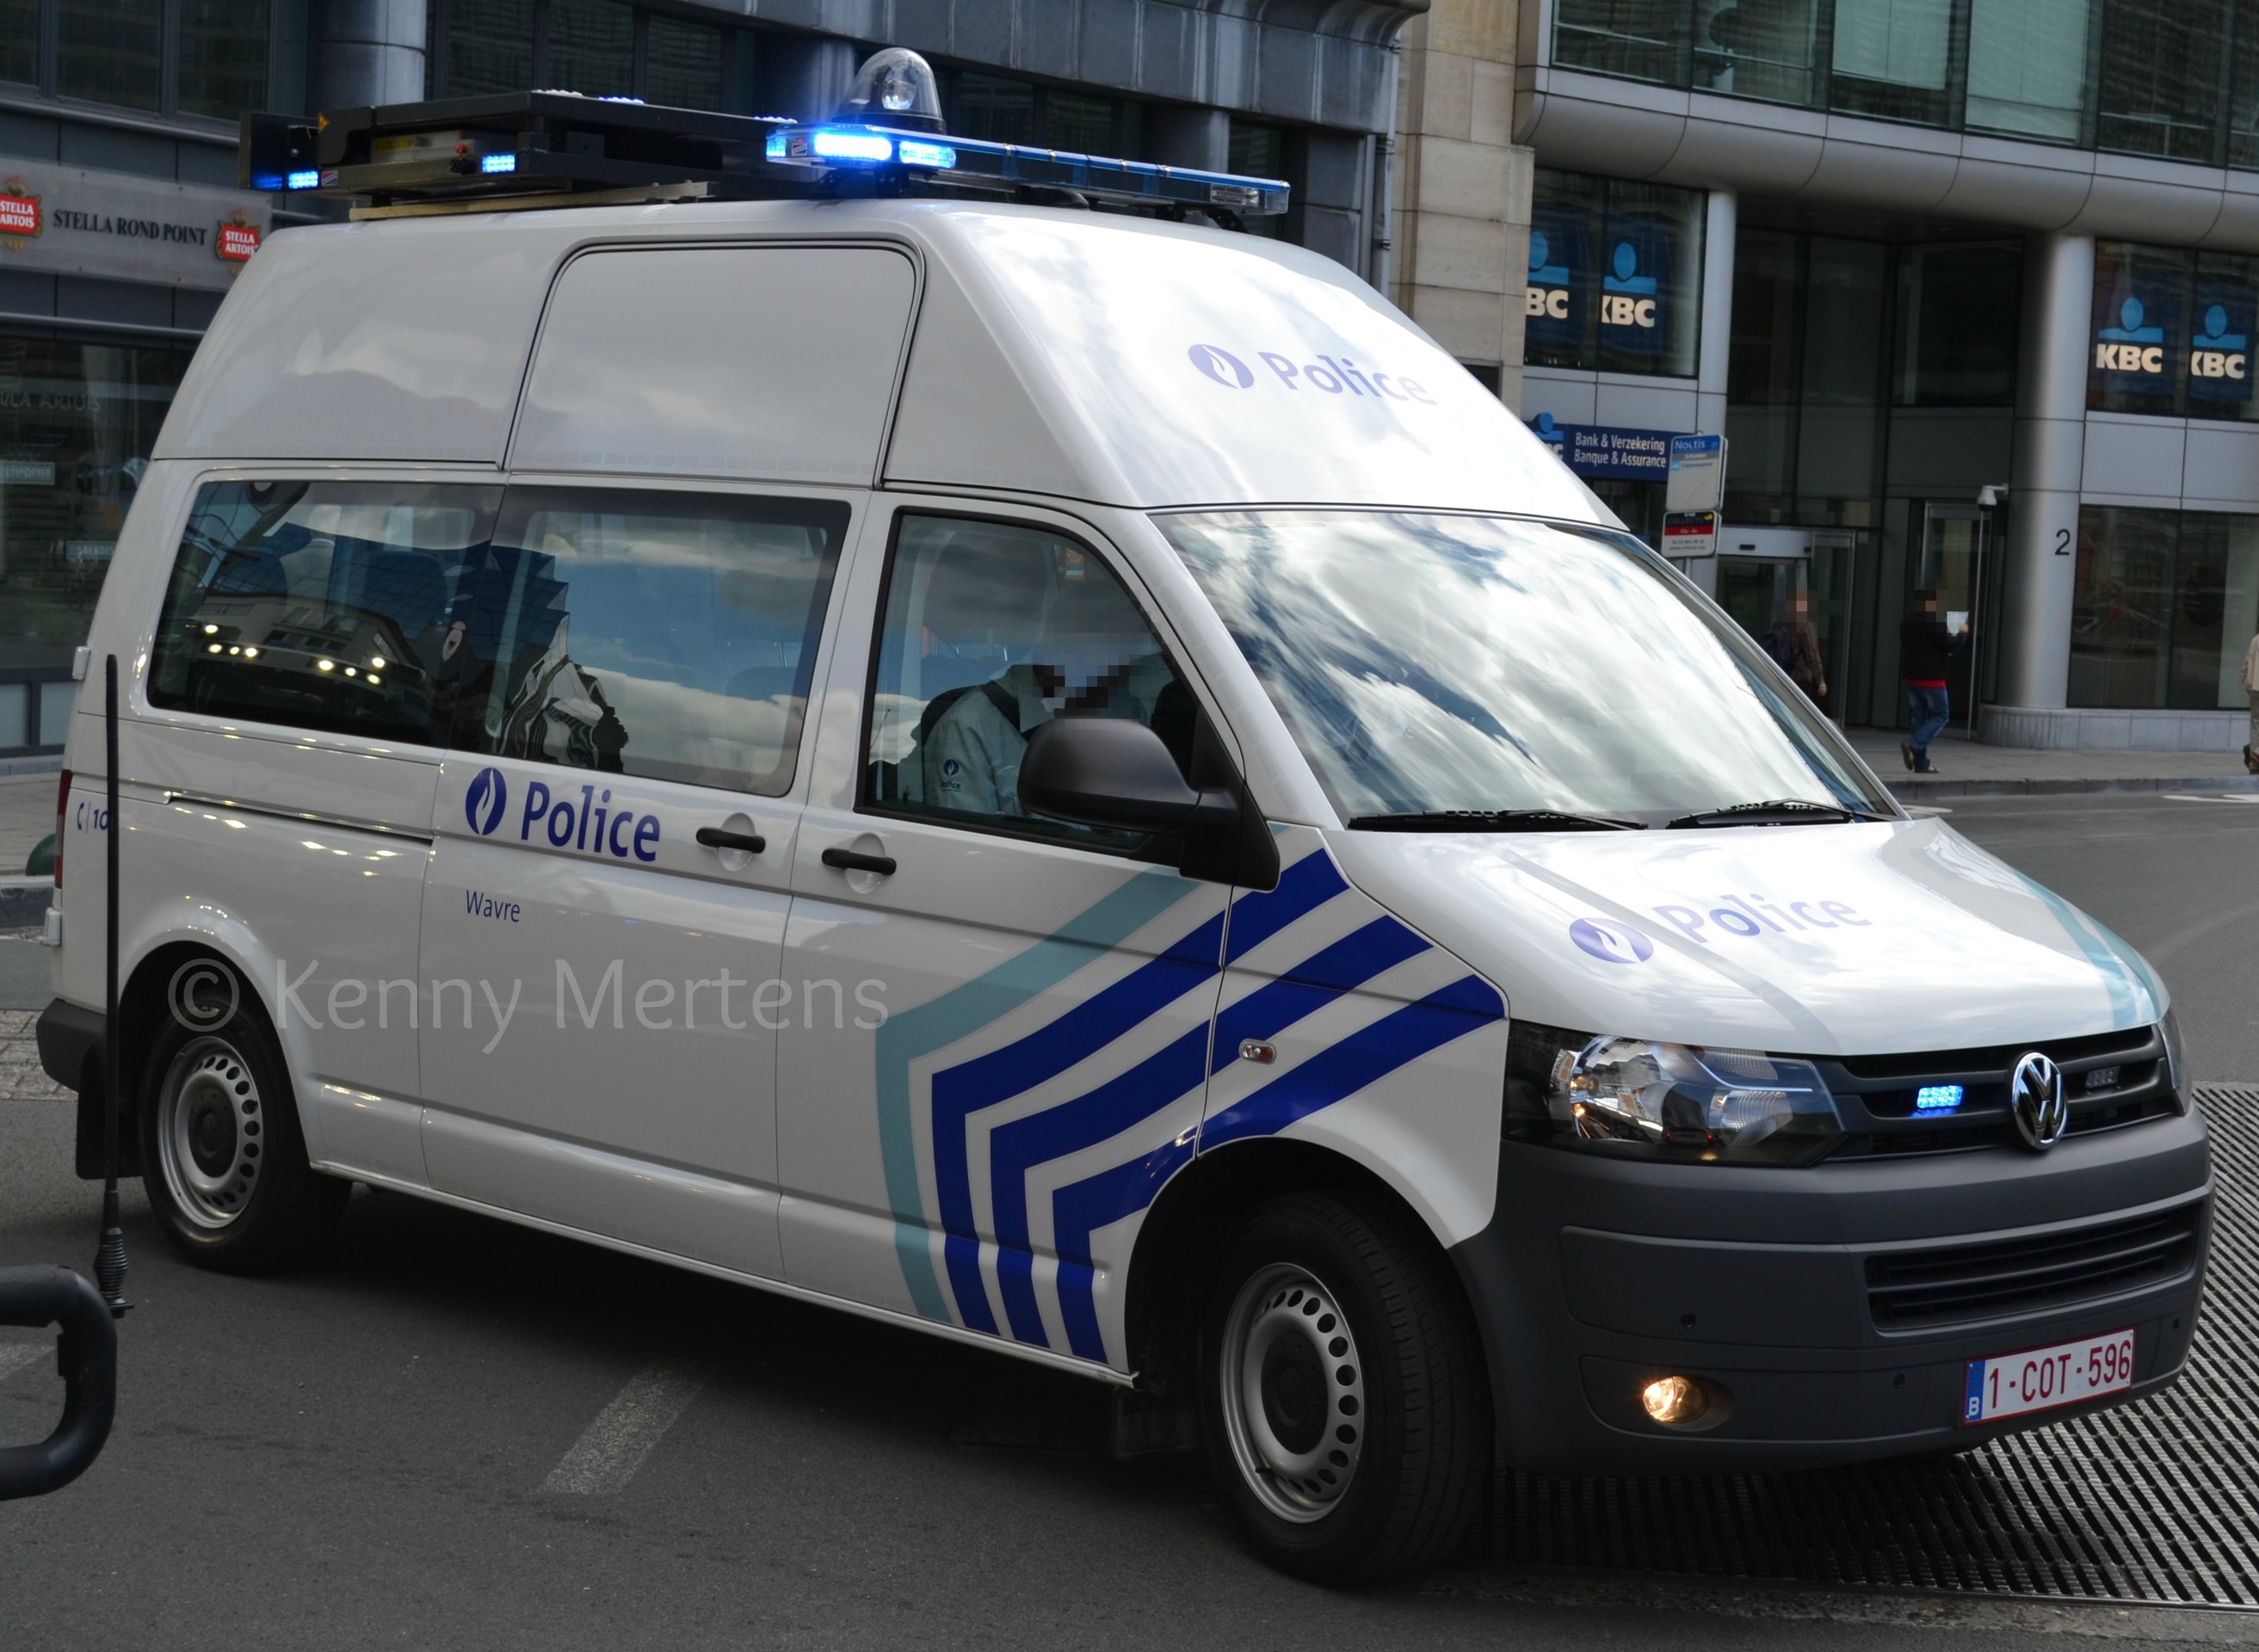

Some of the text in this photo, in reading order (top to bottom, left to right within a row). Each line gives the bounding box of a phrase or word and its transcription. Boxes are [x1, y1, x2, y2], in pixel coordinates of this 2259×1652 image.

[0, 200, 34, 215] STELLA
[0, 214, 34, 228] ARTOIS
[53, 209, 207, 245] STELLA ROND POINT
[225, 231, 255, 243] STELLA
[1526, 287, 1569, 319] BC
[1602, 295, 1656, 328] KBC
[2095, 343, 2163, 373] KBC
[2191, 351, 2245, 379] KBC
[1257, 351, 1438, 405] Police
[1576, 432, 1665, 455] Bank & Verzekering
[1574, 450, 1608, 465] Banque
[1611, 451, 1619, 465] &
[1620, 452, 1666, 468] Assurance
[2055, 528, 2071, 556] 2
[521, 781, 660, 862] Police
[466, 890, 520, 922] Wavre
[1651, 893, 1873, 943] Police
[1989, 1340, 2132, 1409] 1-COT-596
[1968, 1396, 1979, 1416] B
